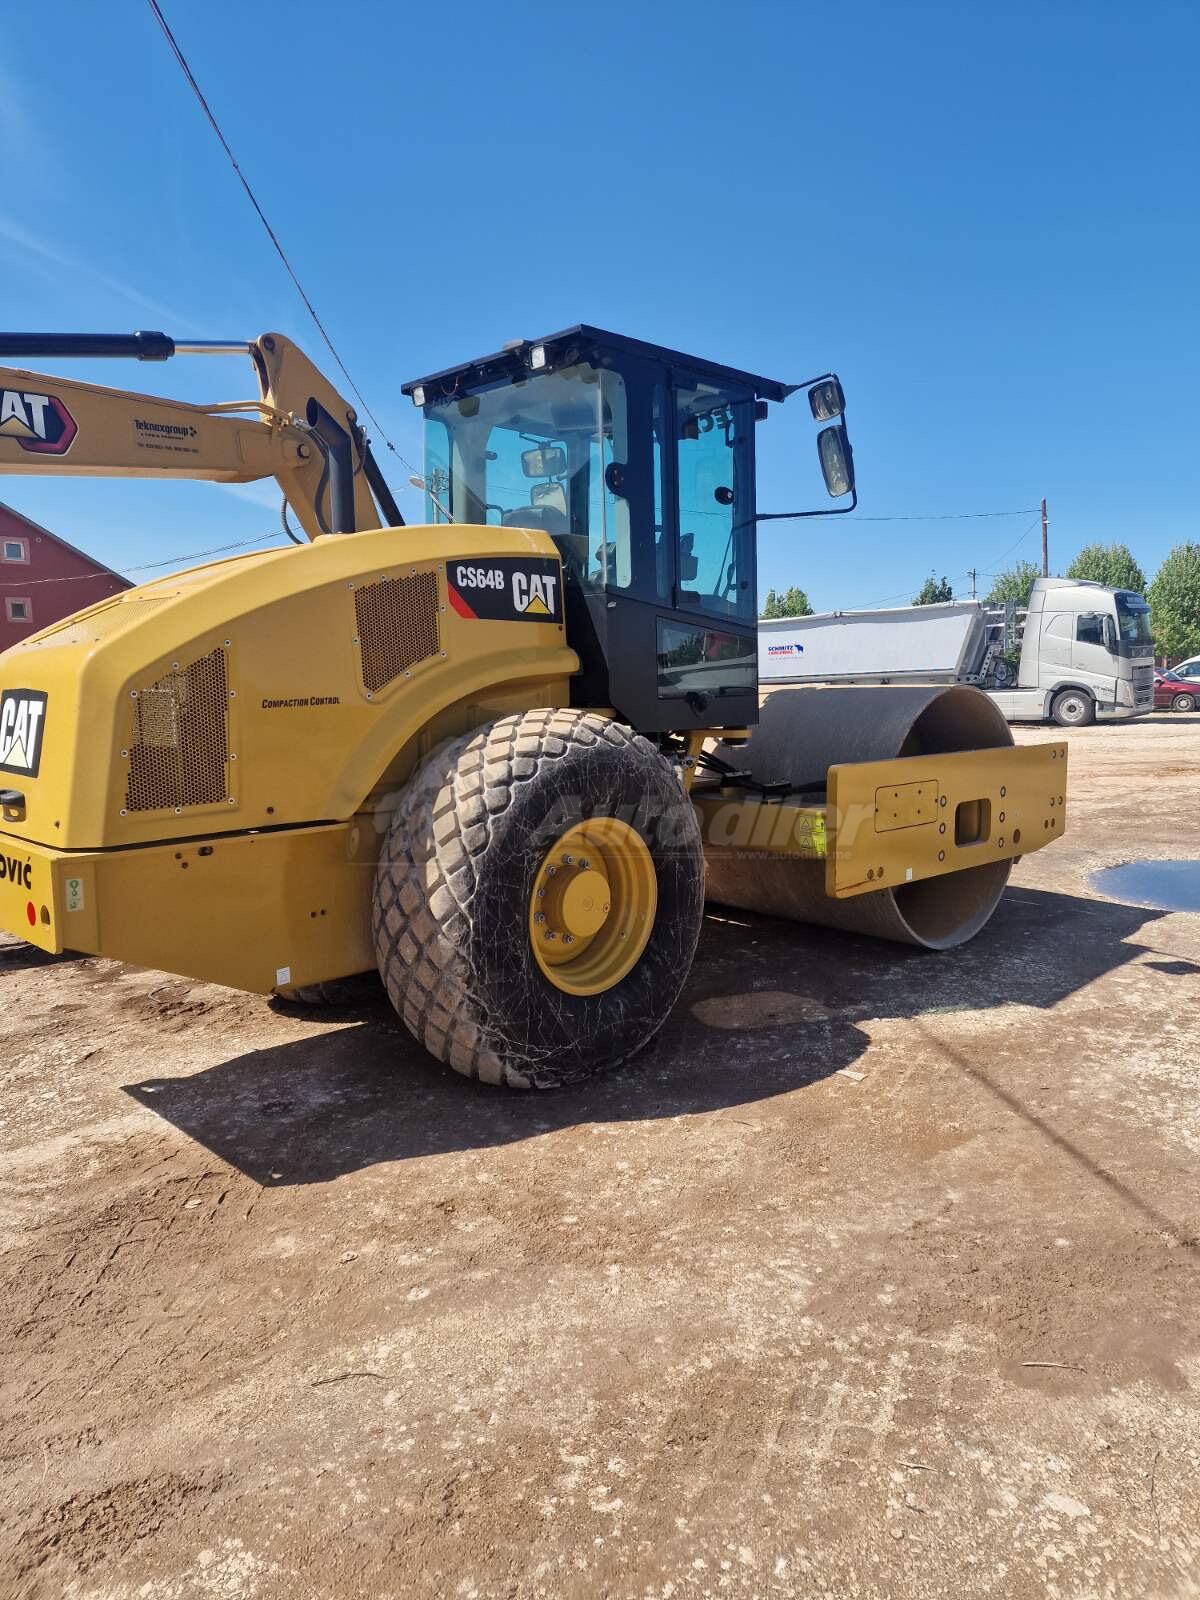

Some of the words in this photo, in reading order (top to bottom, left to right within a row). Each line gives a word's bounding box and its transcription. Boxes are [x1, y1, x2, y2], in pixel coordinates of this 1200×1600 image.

[456, 565, 505, 590] CS64B
[511, 571, 556, 615] CAT
[0, 698, 44, 769] CAT
